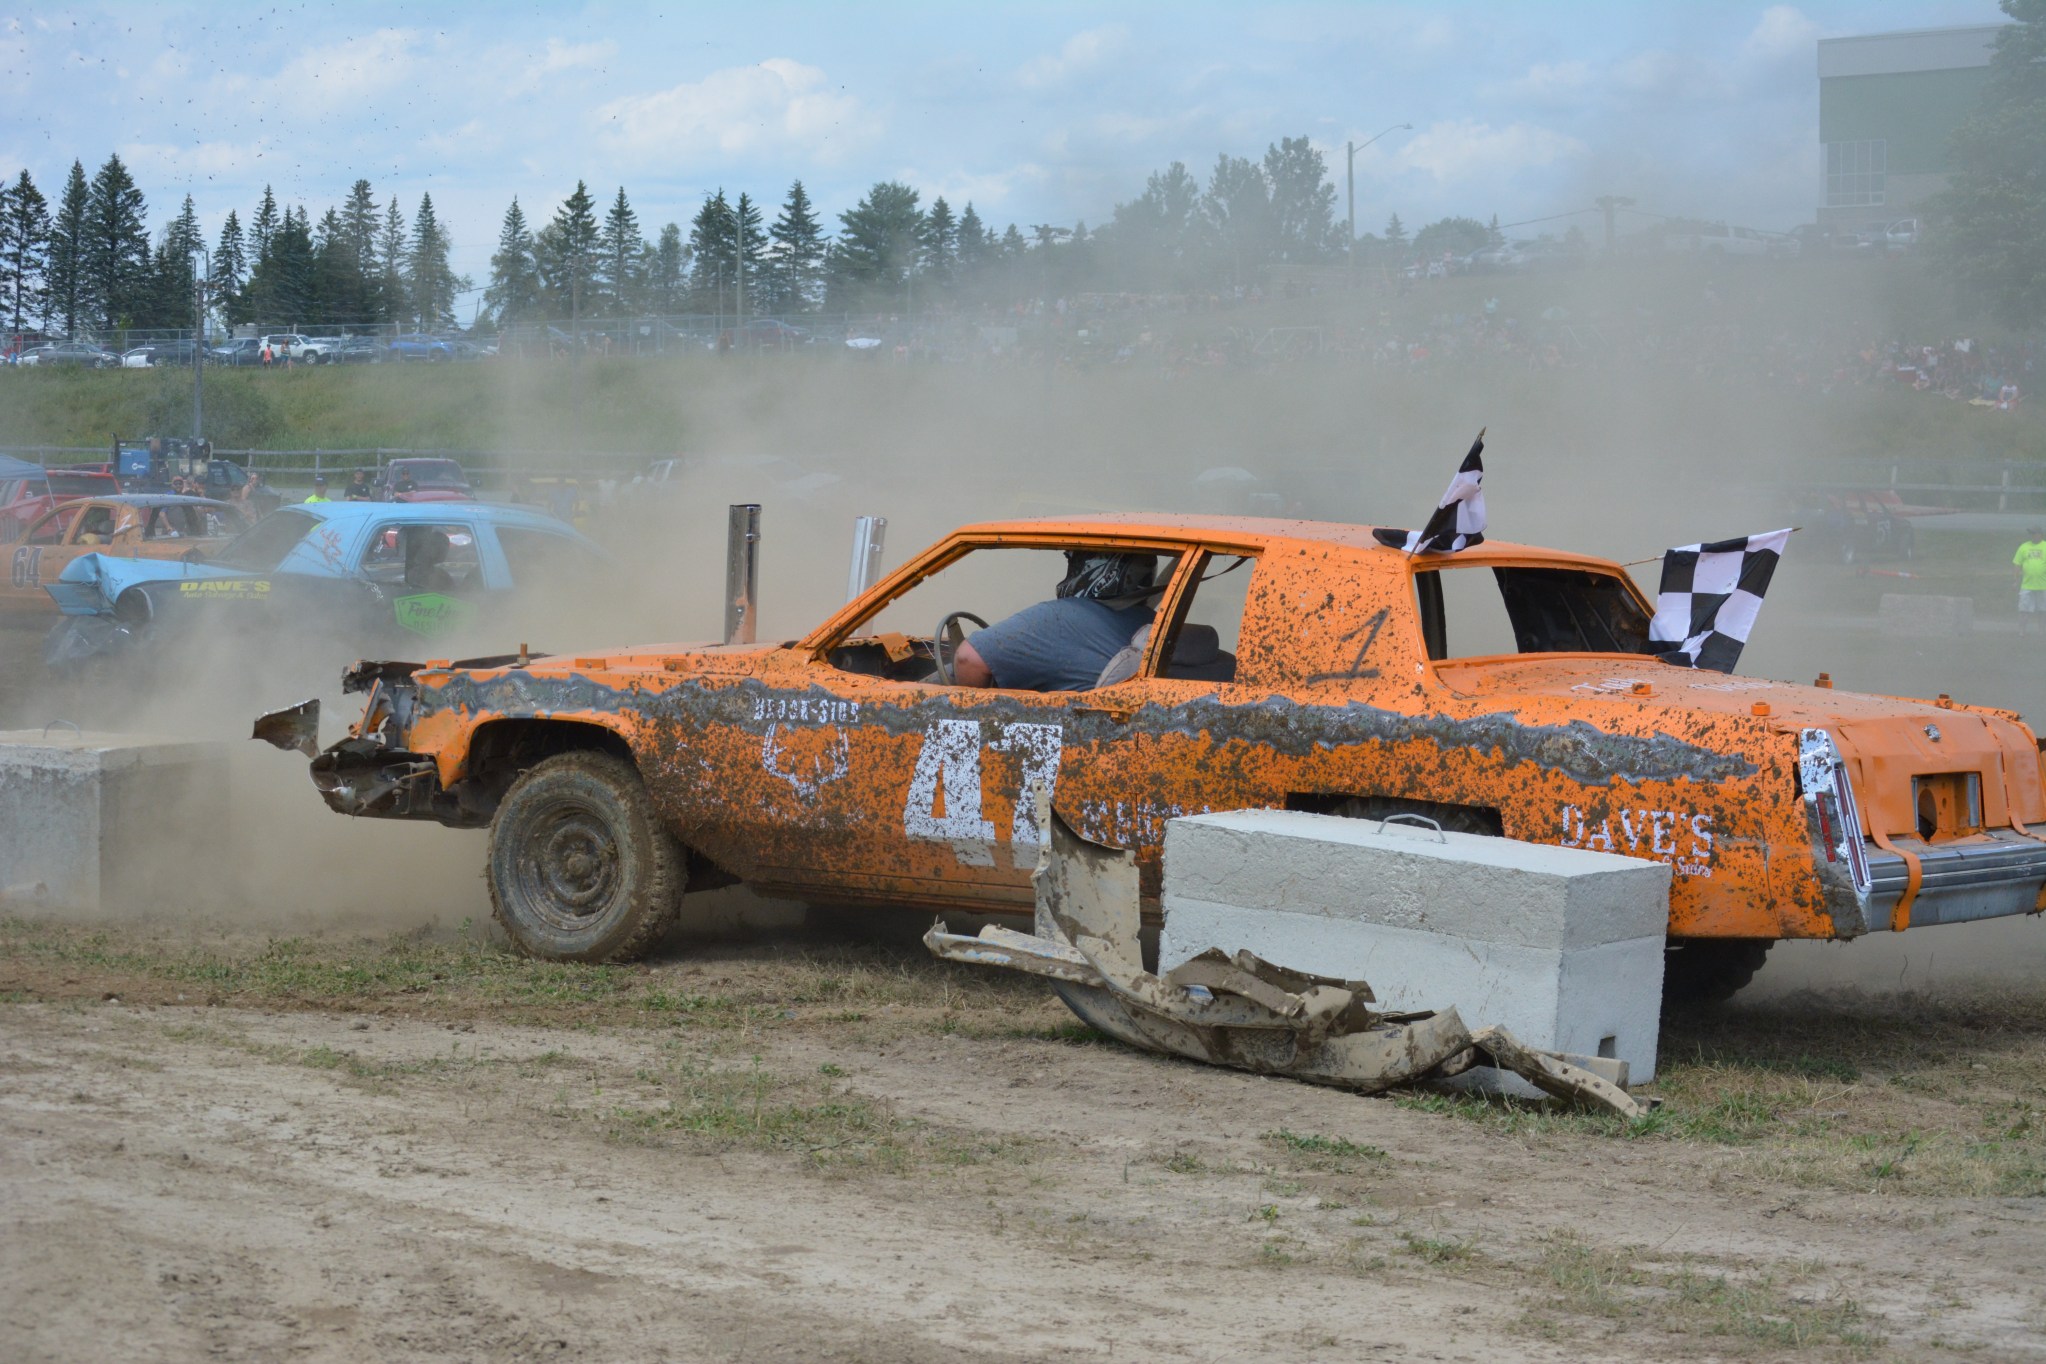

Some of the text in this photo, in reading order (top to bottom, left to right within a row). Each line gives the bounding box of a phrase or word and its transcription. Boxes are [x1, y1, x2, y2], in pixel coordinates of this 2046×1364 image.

[11, 545, 44, 590] 64
[179, 580, 271, 592] DAVE'S
[903, 718, 1063, 868] 47
[1560, 803, 1714, 857] DAVE'S
